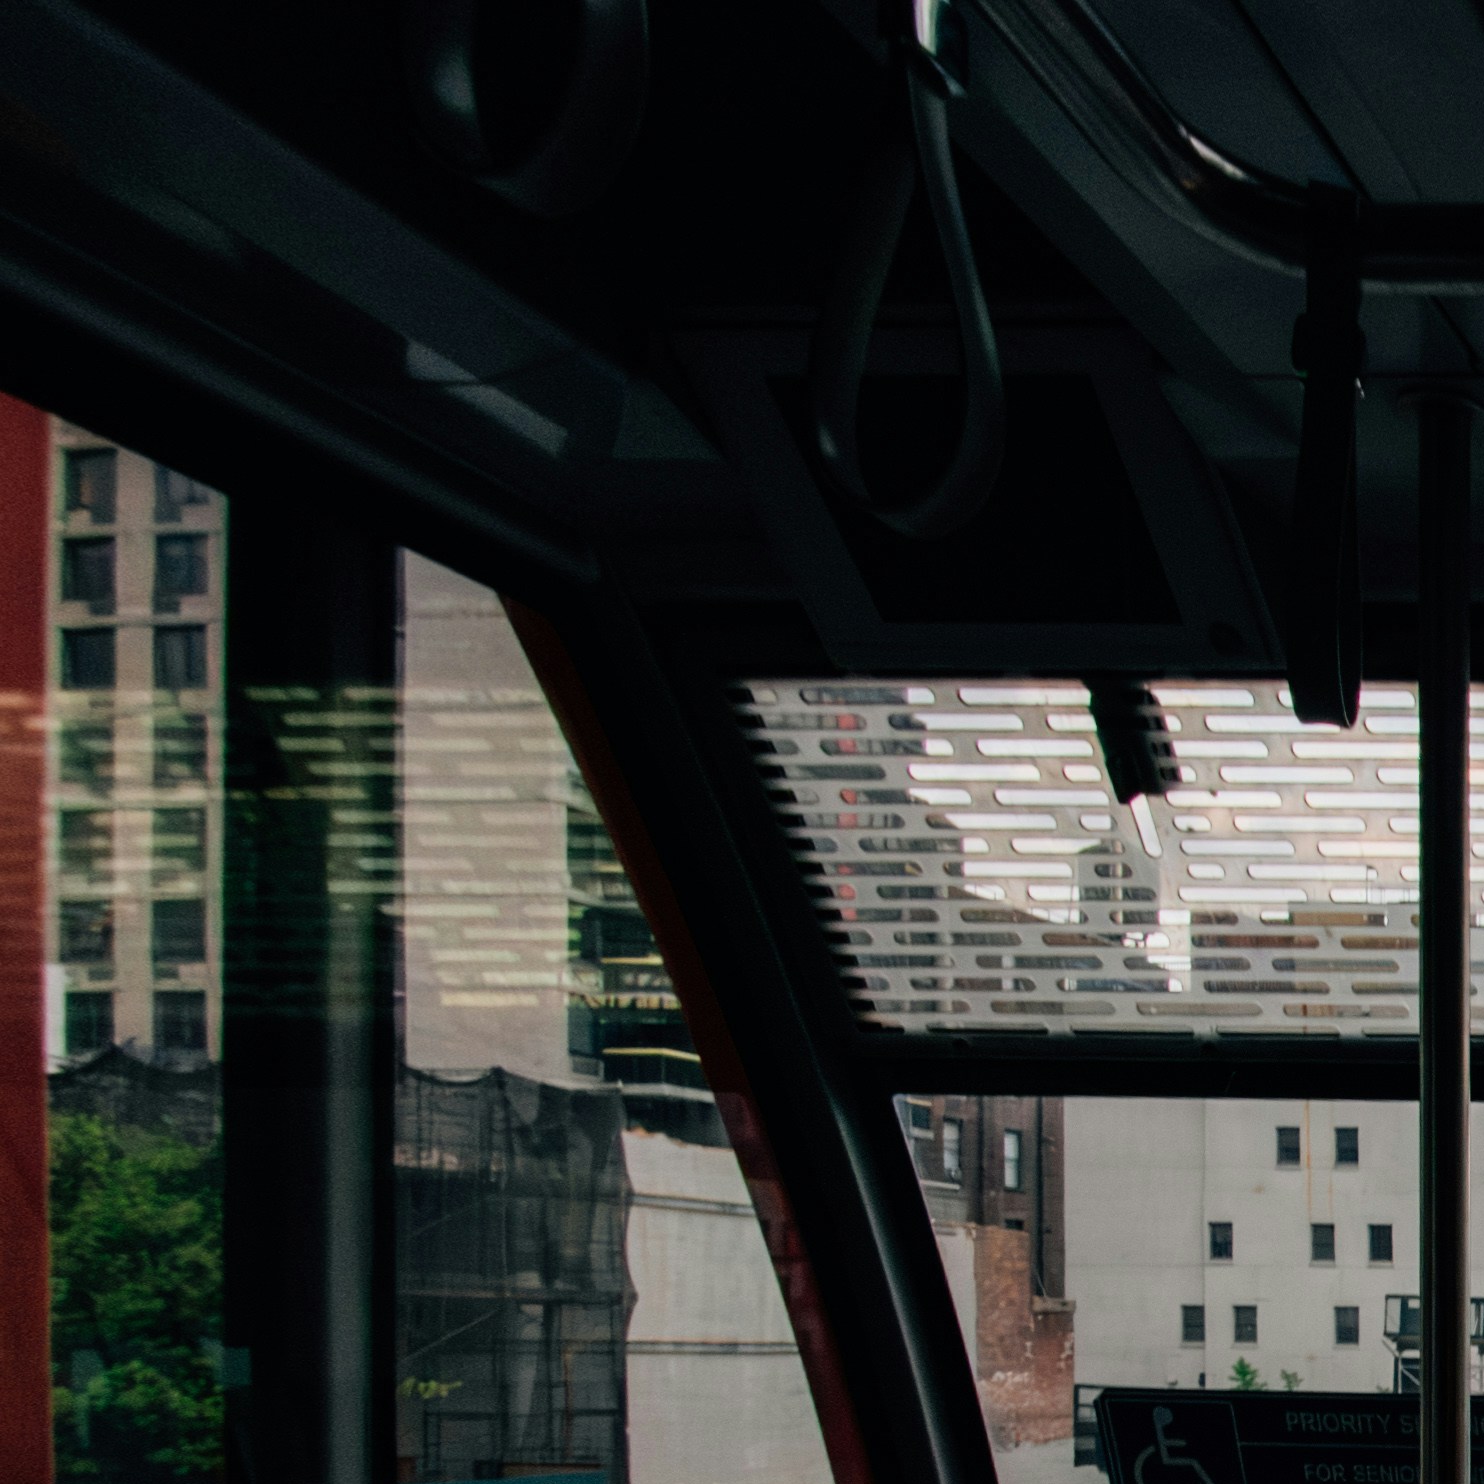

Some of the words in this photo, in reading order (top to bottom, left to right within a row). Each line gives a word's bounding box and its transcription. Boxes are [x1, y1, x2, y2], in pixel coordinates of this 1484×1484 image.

[1284, 1410, 1392, 1435] PRIORITY
[1303, 1462, 1347, 1484] FOR
[1352, 1463, 1420, 1484] SENIO
